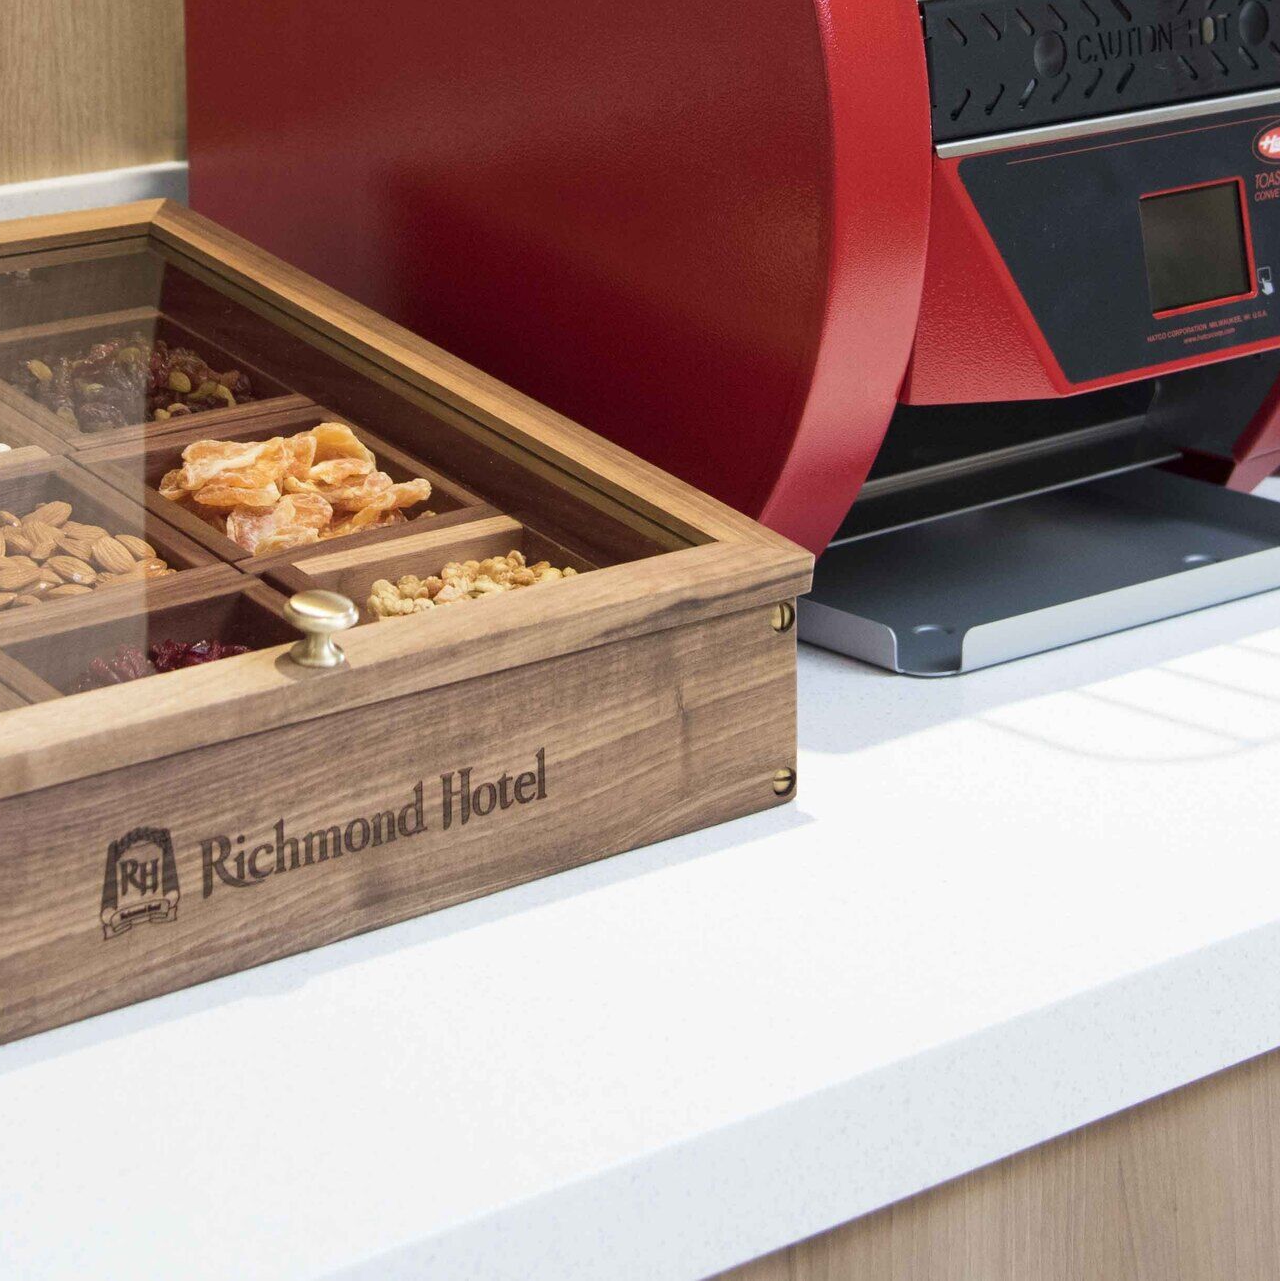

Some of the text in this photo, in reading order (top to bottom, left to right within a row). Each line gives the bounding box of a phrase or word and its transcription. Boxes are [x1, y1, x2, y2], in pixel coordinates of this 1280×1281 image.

[1077, 13, 1231, 64] CAUTION HOT
[1147, 332, 1167, 343] HATCO
[1167, 323, 1207, 339] CORPORATION
[200, 746, 548, 899] Richmond Hotel
[119, 858, 160, 897] RH
